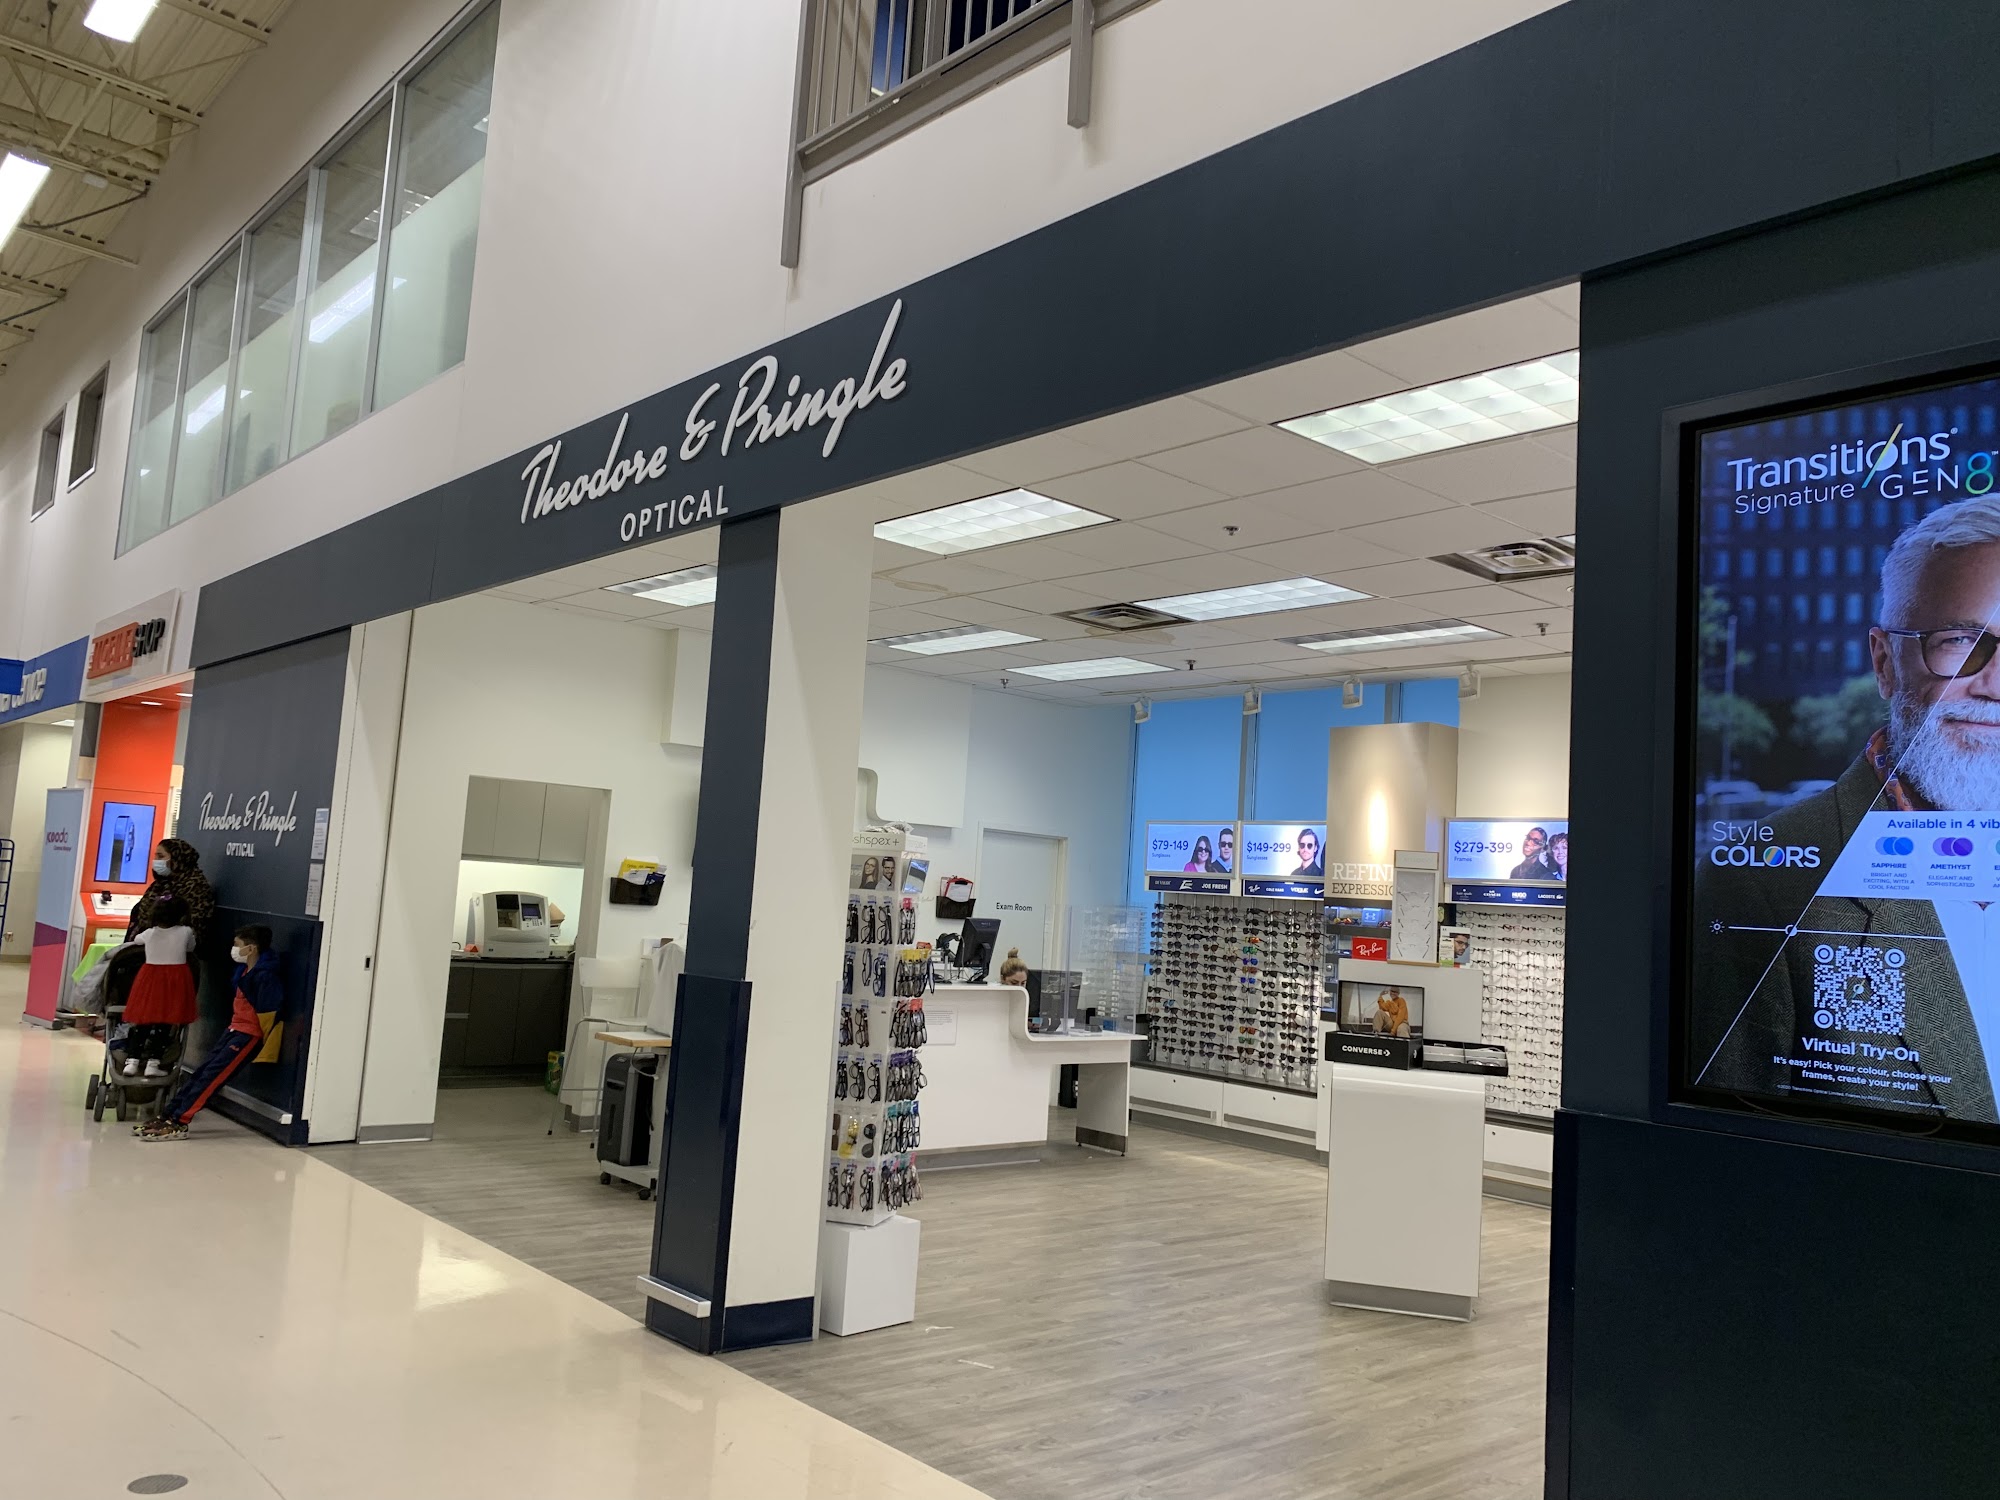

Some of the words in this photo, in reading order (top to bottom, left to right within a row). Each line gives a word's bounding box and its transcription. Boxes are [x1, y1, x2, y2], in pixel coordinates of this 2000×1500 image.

[520, 412, 667, 524] Theodore
[679, 382, 721, 461] &
[720, 298, 908, 458] Pringle
[1734, 483, 1855, 514] Signature
[1880, 464, 1959, 499] GEN
[619, 485, 729, 542] OPTICAL
[199, 791, 242, 831] Theodore
[243, 795, 257, 827] &
[252, 790, 298, 847] Pringle
[1887, 819, 1947, 829] Available
[1950, 819, 1963, 829] in
[1966, 819, 1976, 829] 4
[1711, 821, 1774, 845] Style
[226, 842, 255, 857] OPTICAL
[1152, 838, 1189, 851] $79-149
[1246, 841, 1291, 853] $149-299
[1454, 840, 1513, 854] $279-399
[1710, 845, 1821, 868] COLORS
[996, 902, 1014, 911] Exam
[1014, 903, 1033, 912] Room
[1355, 942, 1383, 956] Ray-Ban
[1341, 1045, 1383, 1056] CONVERSE
[1802, 1037, 1856, 1056] Virtual
[1859, 1042, 1920, 1062] Try-On
[1773, 1055, 1787, 1065] It's
[1788, 1059, 1812, 1068] easy!
[1813, 1060, 1833, 1070] Pick
[1834, 1064, 1856, 1072] your
[1857, 1067, 1890, 1077] colour,
[1892, 1070, 1927, 1080] choose
[1928, 1074, 1952, 1084] your
[1802, 1070, 1836, 1082] frames,
[1837, 1075, 1867, 1085] create
[1868, 1079, 1891, 1087] your
[1892, 1081, 1919, 1091] style!
